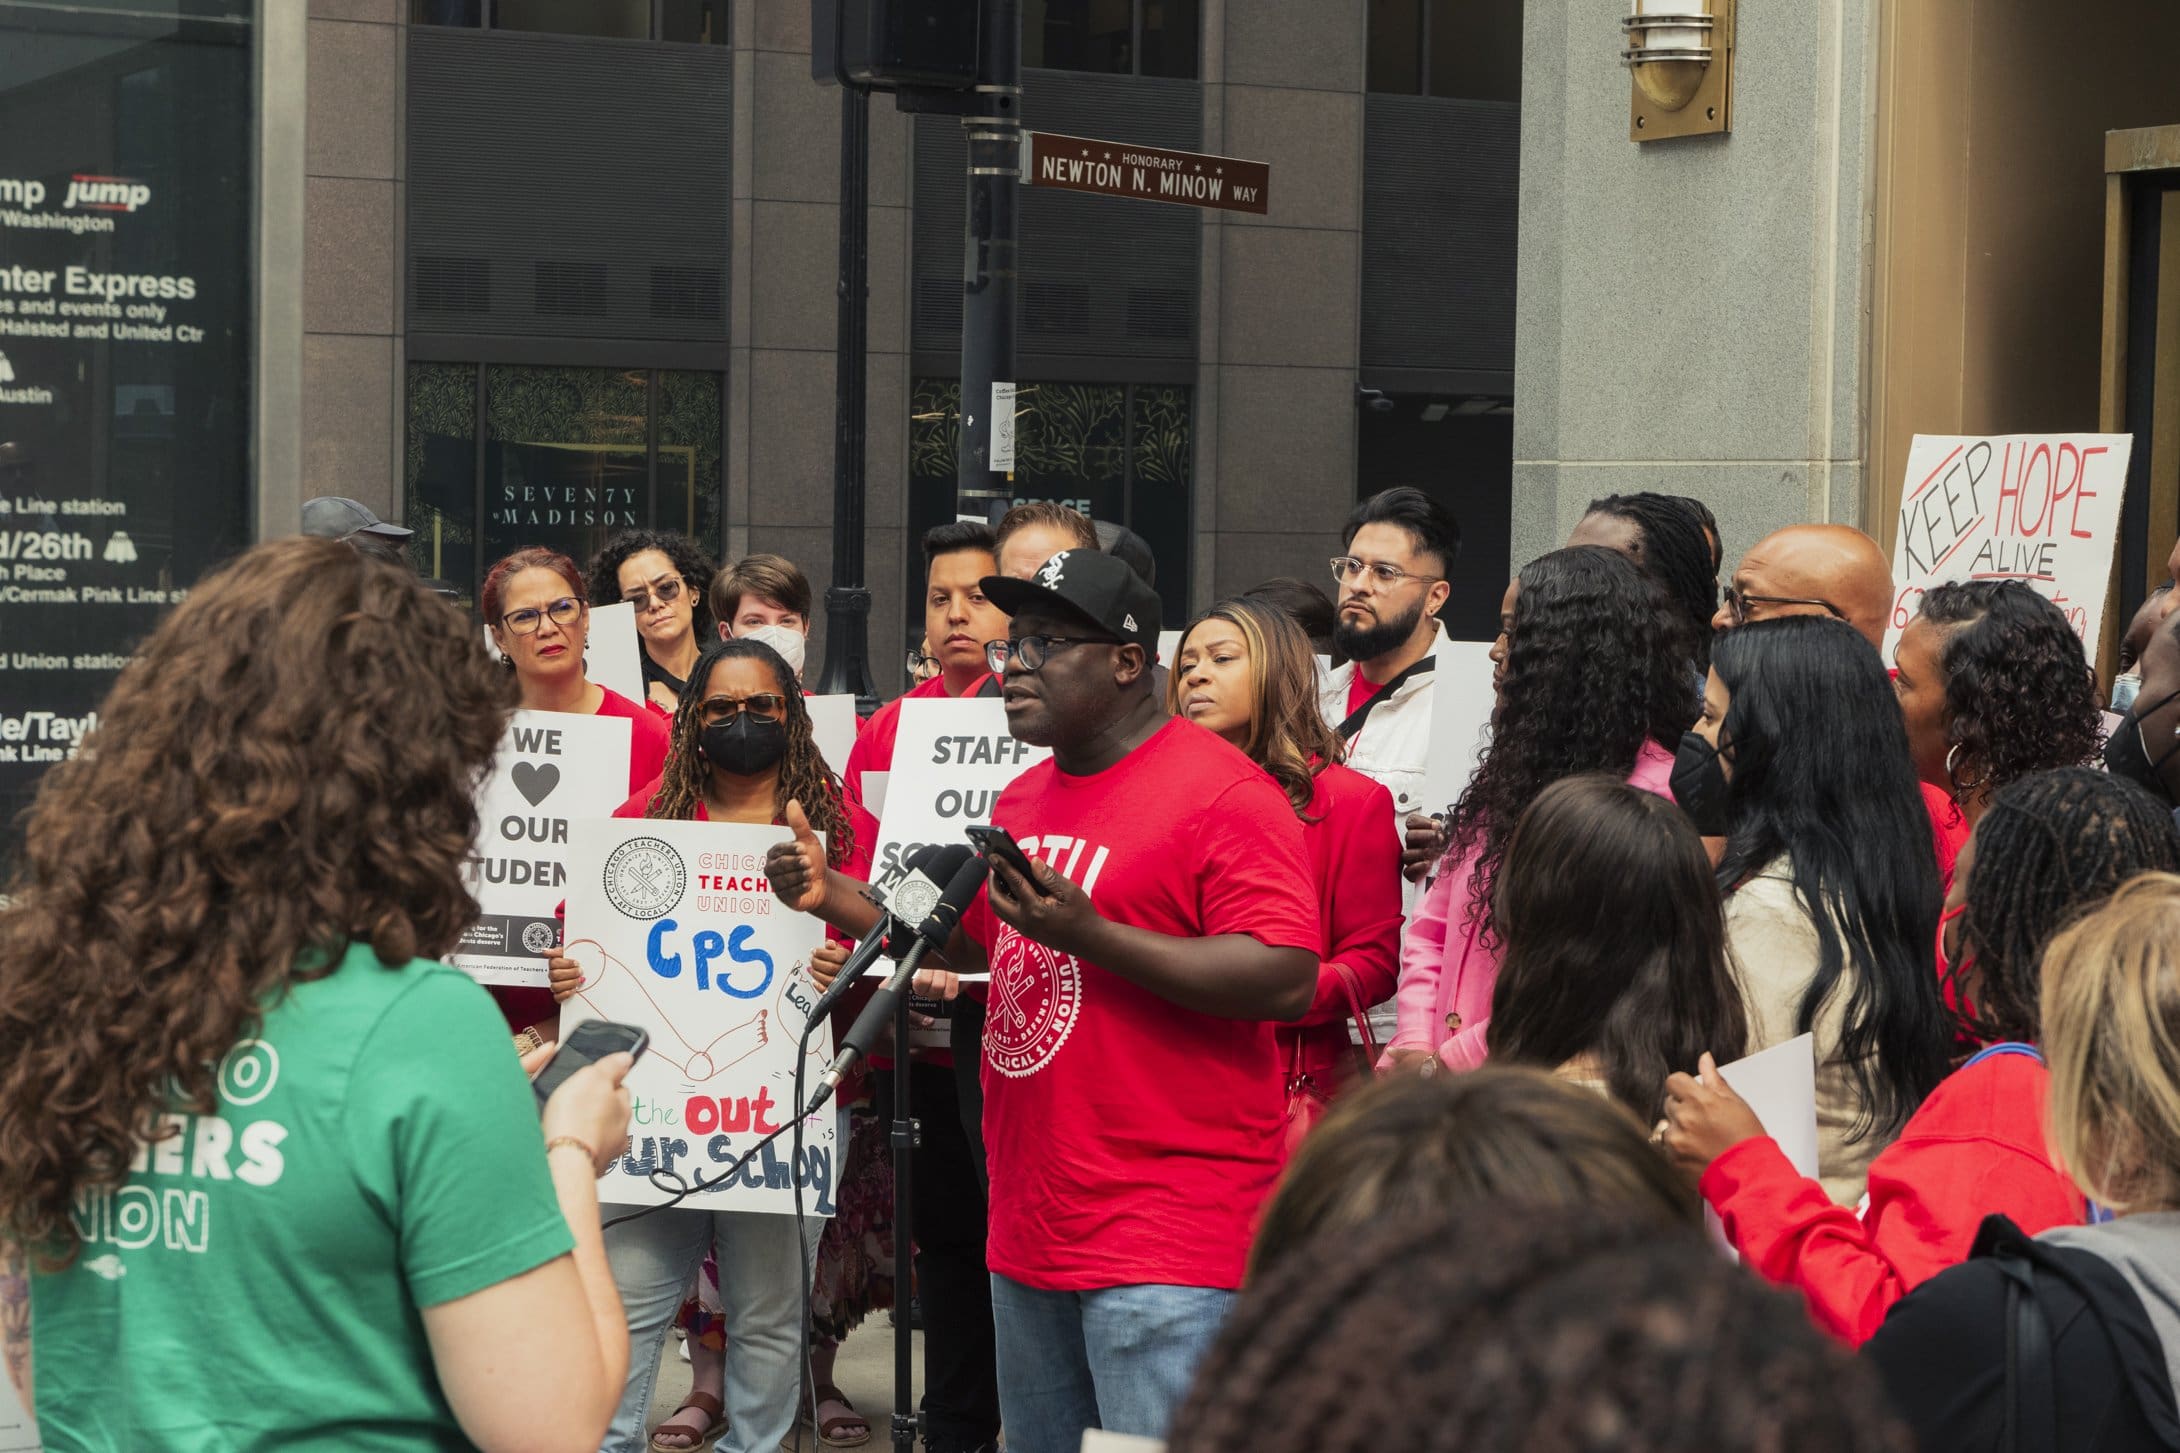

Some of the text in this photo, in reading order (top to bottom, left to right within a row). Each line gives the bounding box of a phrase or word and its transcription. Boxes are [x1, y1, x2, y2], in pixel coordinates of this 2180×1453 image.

[1122, 152, 1183, 171] HONORARY
[1042, 155, 1258, 203] NEWTON N. MINOW WAY
[63, 181, 150, 212] jump
[65, 266, 196, 302] Express
[19, 297, 56, 315] and
[60, 301, 122, 318] events
[126, 302, 167, 323] only
[73, 321, 109, 339] and
[113, 323, 172, 341] United
[176, 325, 205, 343] Ctr
[15, 496, 58, 514] Line
[61, 498, 126, 516] station
[504, 486, 635, 503] SEVEN7Y
[502, 508, 636, 526] MADISON
[1901, 441, 2109, 580] KEEP HOPE
[1969, 538, 2057, 576] ALIVE
[14, 563, 67, 581] Place
[82, 586, 123, 603] Pink
[126, 586, 166, 603] Line
[12, 652, 69, 670] Union
[21, 744, 64, 762] Line
[512, 727, 562, 755] WE
[931, 735, 1029, 764] STAFF
[500, 815, 568, 844] OUR
[607, 841, 683, 896] CHICAGO TEACHERS UNION
[698, 875, 775, 893] TEACH
[617, 900, 633, 913] AFT
[635, 907, 664, 917] LOCAL
[697, 896, 770, 915] UNION
[646, 918, 775, 999] CPS
[1028, 943, 1049, 979] UNITE
[1051, 964, 1074, 1033] UNION
[1020, 998, 1049, 1042] DEFEND
[998, 1053, 1035, 1069] LOCAL
[632, 1095, 679, 1126] the
